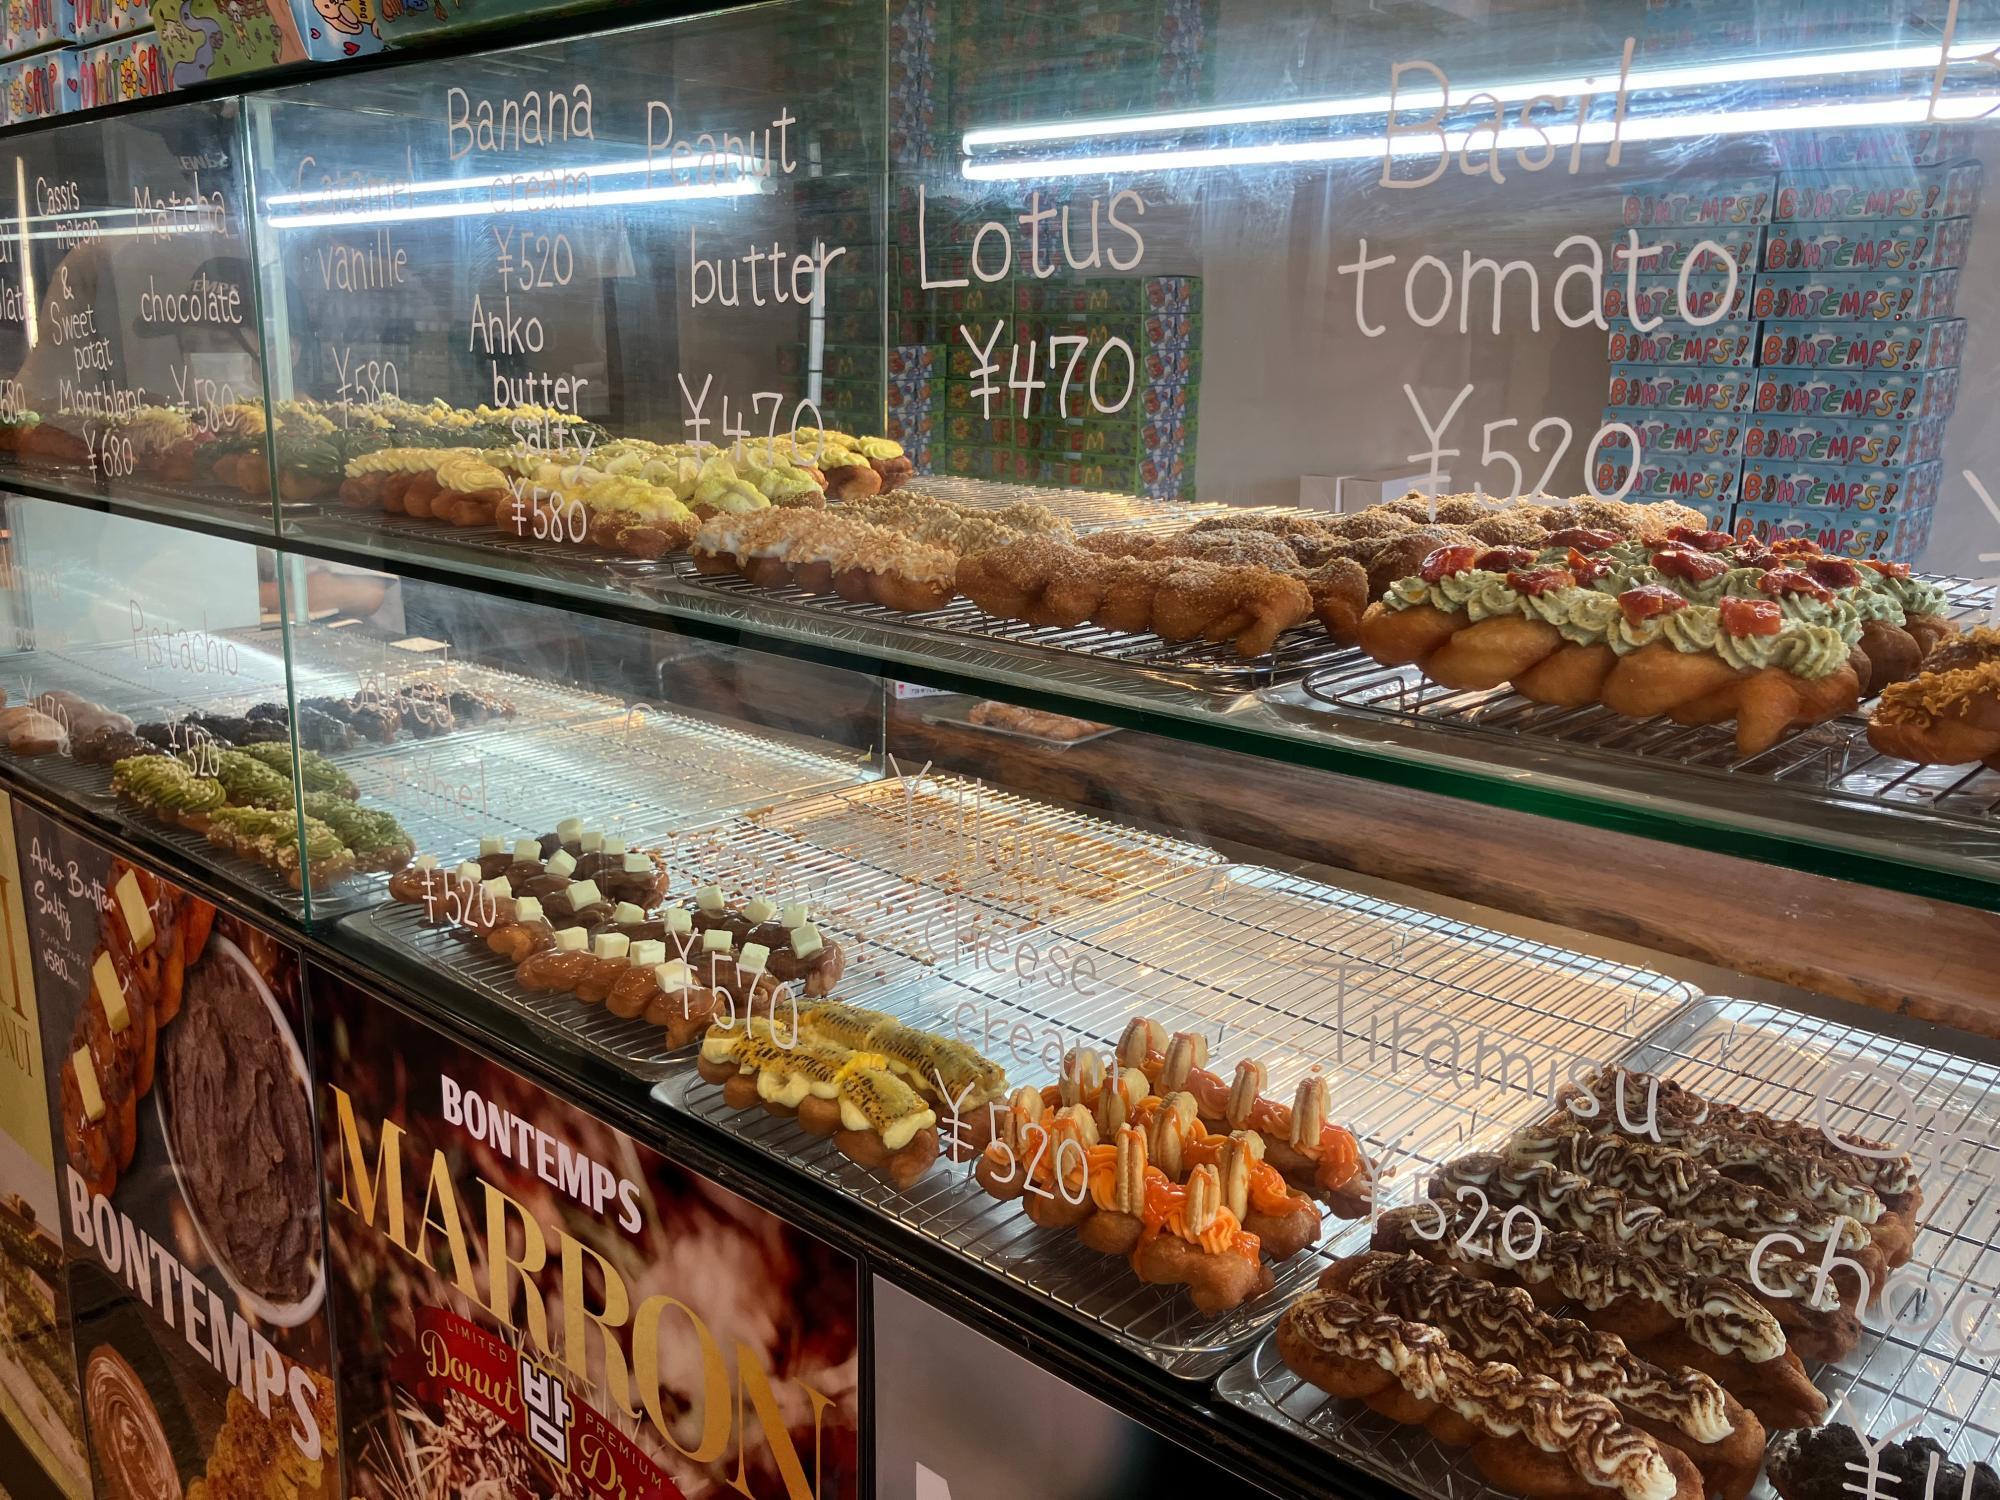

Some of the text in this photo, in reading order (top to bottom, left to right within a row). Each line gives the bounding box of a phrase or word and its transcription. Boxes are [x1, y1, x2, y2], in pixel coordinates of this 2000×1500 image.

[447, 84, 594, 160] Banana
[646, 101, 797, 189] Peanut
[1378, 37, 1636, 189] Basil
[36, 176, 80, 218] Cassis
[133, 171, 227, 243] Matcha
[491, 168, 592, 213] cream
[318, 229, 407, 292] vanille
[493, 225, 574, 292] ¥520
[691, 225, 846, 308] butter
[919, 184, 1145, 290] Lotus
[61, 266, 75, 300] &
[141, 272, 243, 324] chocolate
[1338, 228, 1740, 338] tomato
[1754, 285, 1914, 322] BONTEMPS!
[50, 301, 97, 345] Sweet
[470, 294, 544, 355] Anko
[1763, 335, 1923, 370] BONTEMPS!
[73, 337, 114, 383] potat
[332, 346, 400, 430] ¥580
[492, 360, 589, 415] butter
[960, 319, 1136, 421] ¥470
[1609, 379, 1751, 413] BONTEMPS!
[170, 364, 236, 438] ¥580
[677, 373, 824, 474] ¥470
[1758, 379, 1917, 420] BONTEMPS!
[83, 420, 134, 484] ¥680
[512, 414, 596, 484] salty
[1403, 383, 1642, 521] ¥520
[1745, 427, 1901, 467] BONTEMPS!
[508, 474, 587, 543] ¥580
[1743, 470, 1900, 514] BONTEMPS!
[129, 599, 239, 676] Pistachio
[165, 709, 220, 778] ¥520
[888, 753, 1080, 885] Yellow
[30, 837, 65, 880] Anko
[420, 858, 497, 929] ¥520
[34, 880, 72, 941] Salty
[924, 892, 1097, 996] Cheese
[43, 947, 69, 982] ¥580
[670, 927, 800, 1050] ¥570
[955, 1002, 1120, 1095] cream
[1302, 961, 1661, 1143] Tiramisu
[441, 1073, 641, 1233] BONTEMPS
[935, 1069, 1088, 1205] ¥520
[1350, 1125, 1542, 1260] ¥520
[66, 1163, 322, 1460] BONTEMPS
[328, 1083, 836, 1500] MARRON
[421, 1329, 519, 1414] Donut
[446, 1318, 508, 1363] LIMITED
[519, 1356, 572, 1467] 밤
[585, 1412, 662, 1489] PREMIUM
